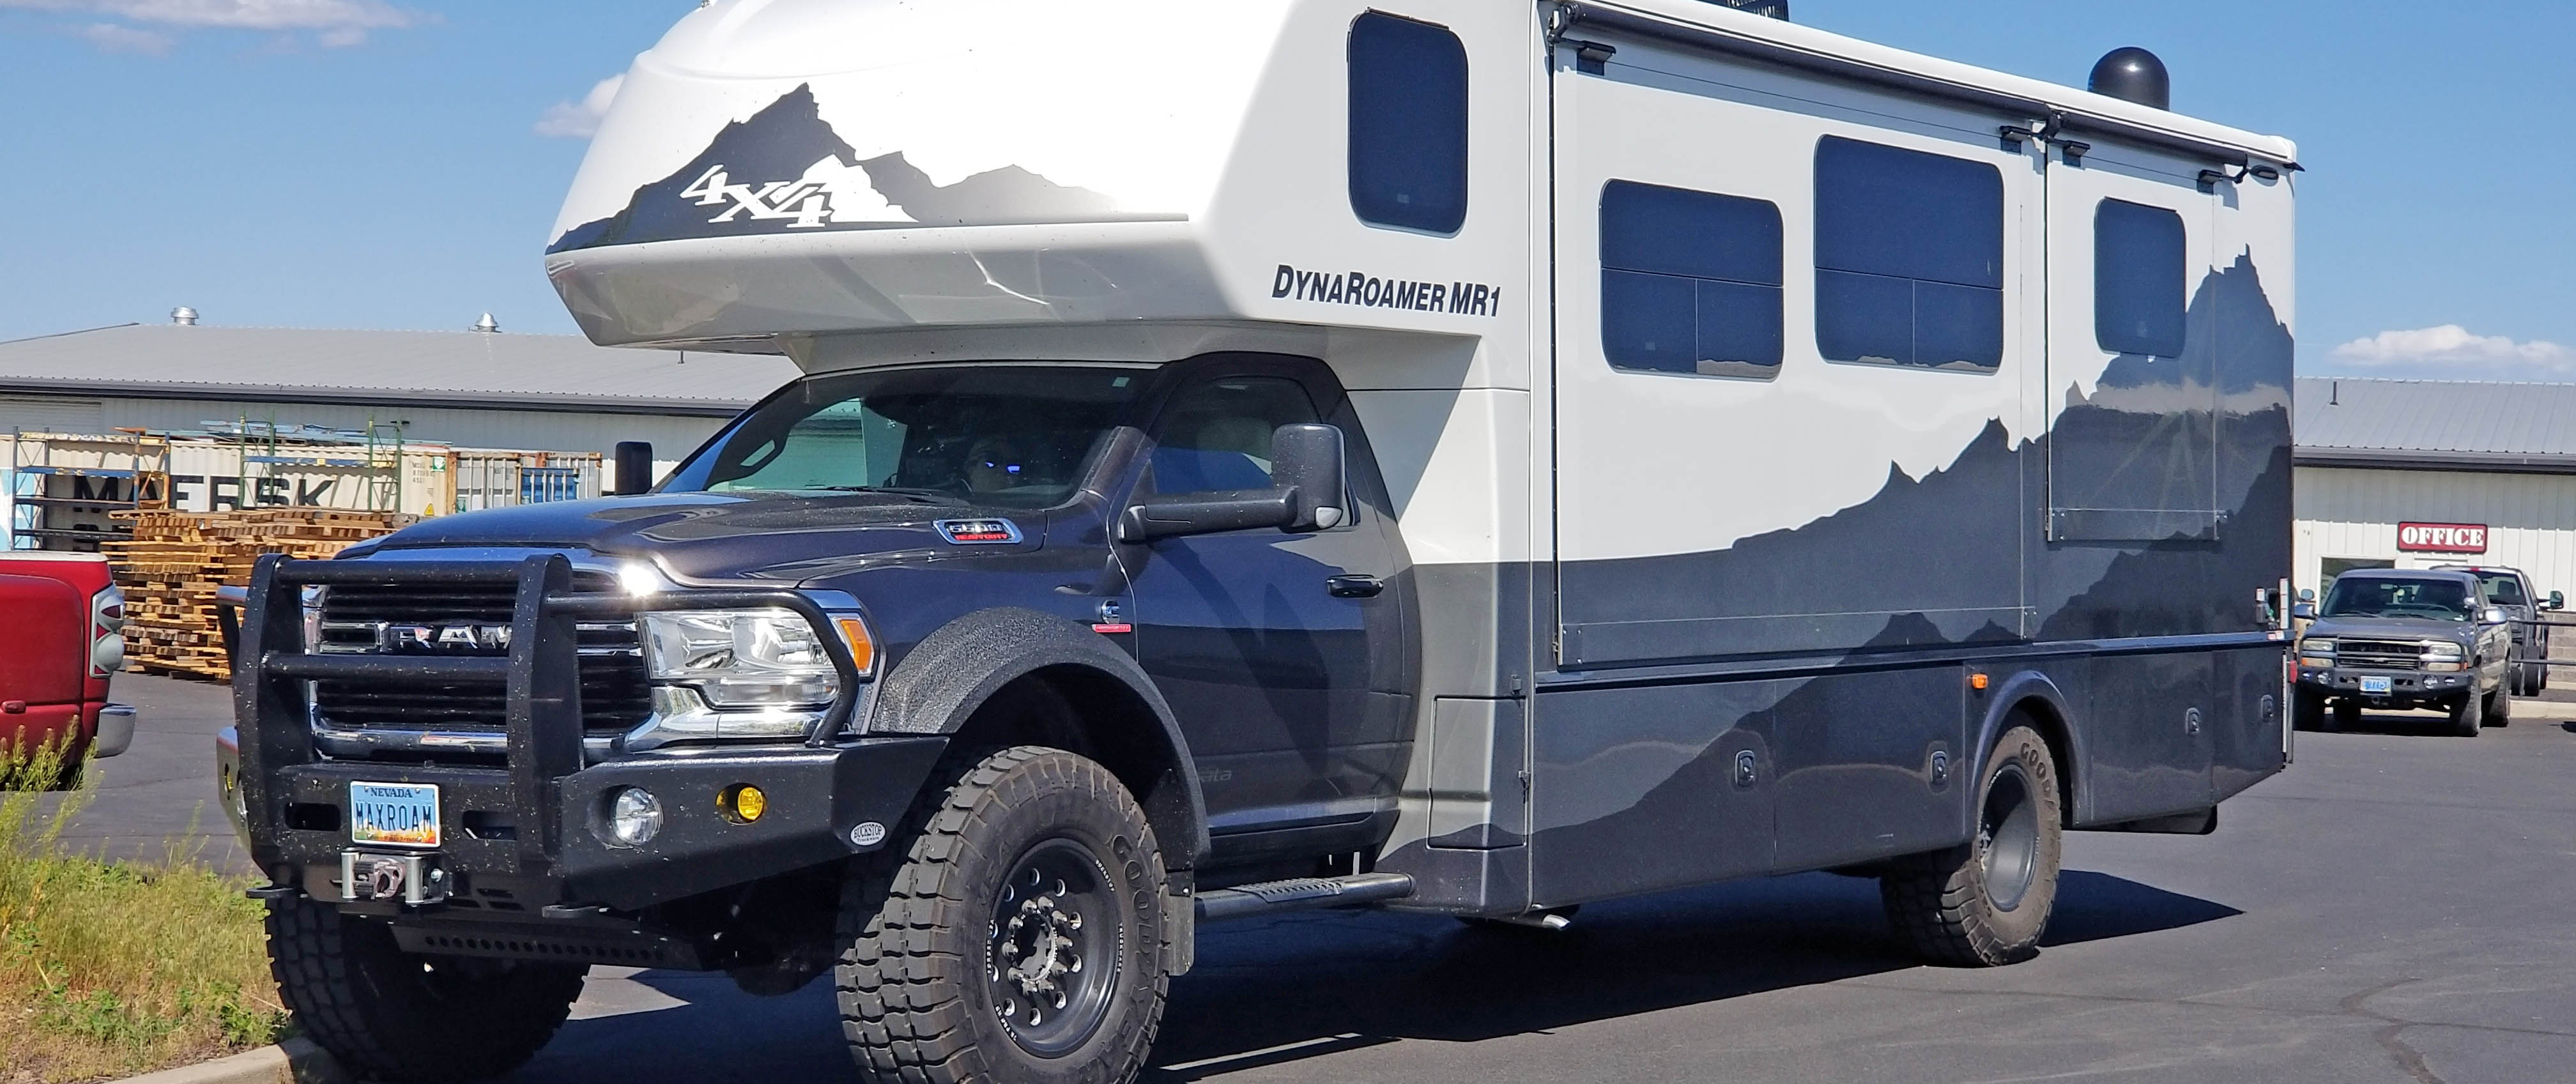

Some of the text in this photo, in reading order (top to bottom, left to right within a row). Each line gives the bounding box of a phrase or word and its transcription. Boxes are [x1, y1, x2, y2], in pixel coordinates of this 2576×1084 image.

[1271, 264, 1501, 317] DYNAROAMER MR1
[73, 475, 337, 513] MAERSK
[2401, 526, 2484, 547] OFFICE
[389, 625, 512, 649] RAM
[370, 787, 413, 798] NEVADA
[356, 802, 432, 832] MAXROAM
[854, 824, 882, 839] BUCKSTOP
